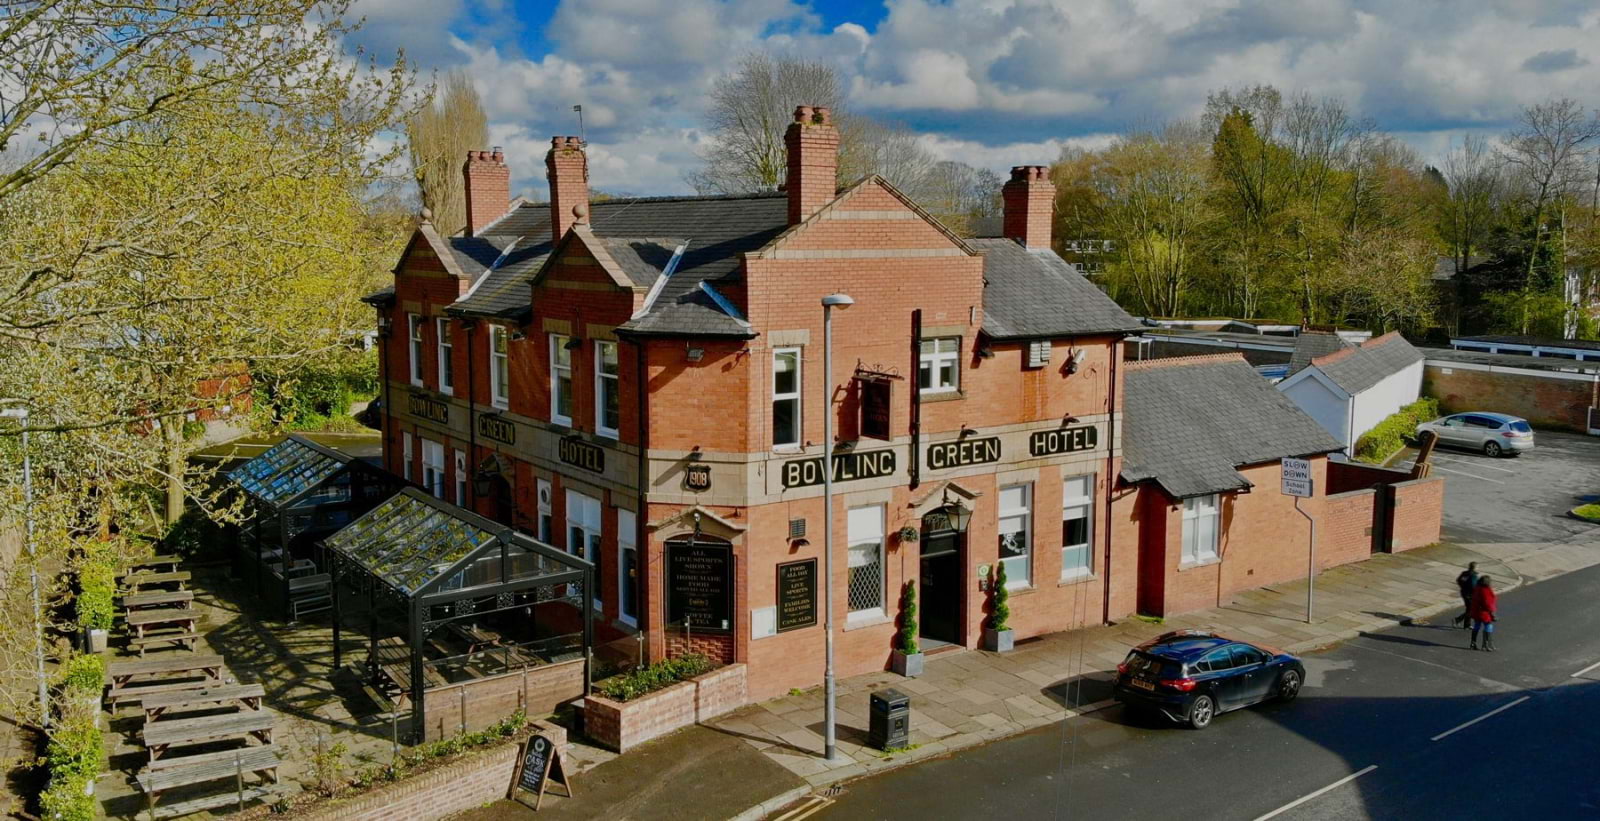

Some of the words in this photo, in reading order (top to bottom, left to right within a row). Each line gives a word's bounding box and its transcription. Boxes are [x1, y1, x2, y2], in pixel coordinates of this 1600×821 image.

[480, 416, 513, 443] GREEN
[560, 438, 602, 470] HOTEL
[933, 439, 998, 467] GREEN
[1035, 428, 1094, 454] HOTEL
[1284, 461, 1307, 469] SLOW
[689, 471, 706, 486] 1908
[1284, 470, 1307, 478] DOWN
[786, 587, 808, 595] SPORTS
[525, 754, 545, 767] CASK
